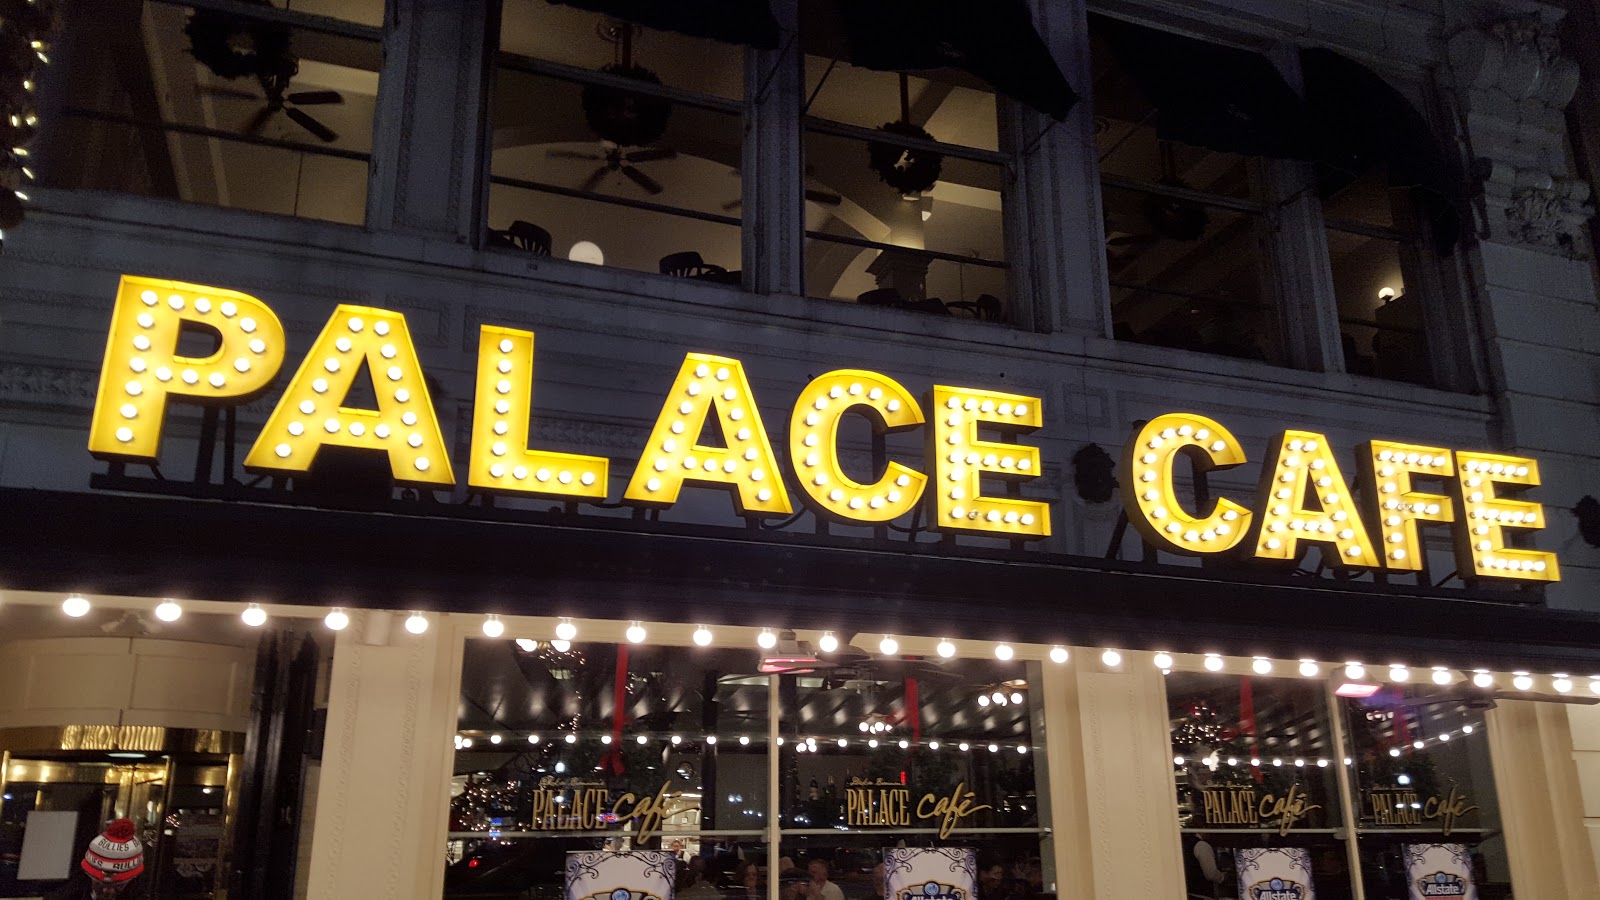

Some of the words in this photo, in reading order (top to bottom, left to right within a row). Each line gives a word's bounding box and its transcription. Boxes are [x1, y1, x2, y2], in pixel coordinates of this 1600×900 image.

[88, 274, 1052, 537] PALACE
[1127, 412, 1561, 583] CAFE
[531, 789, 609, 830] PALACE
[846, 789, 910, 826] PALACE
[1202, 790, 1258, 824] PALACE
[1370, 793, 1421, 825] PALACE
[98, 838, 130, 852] BULLIES
[1426, 883, 1460, 895] Allstate
